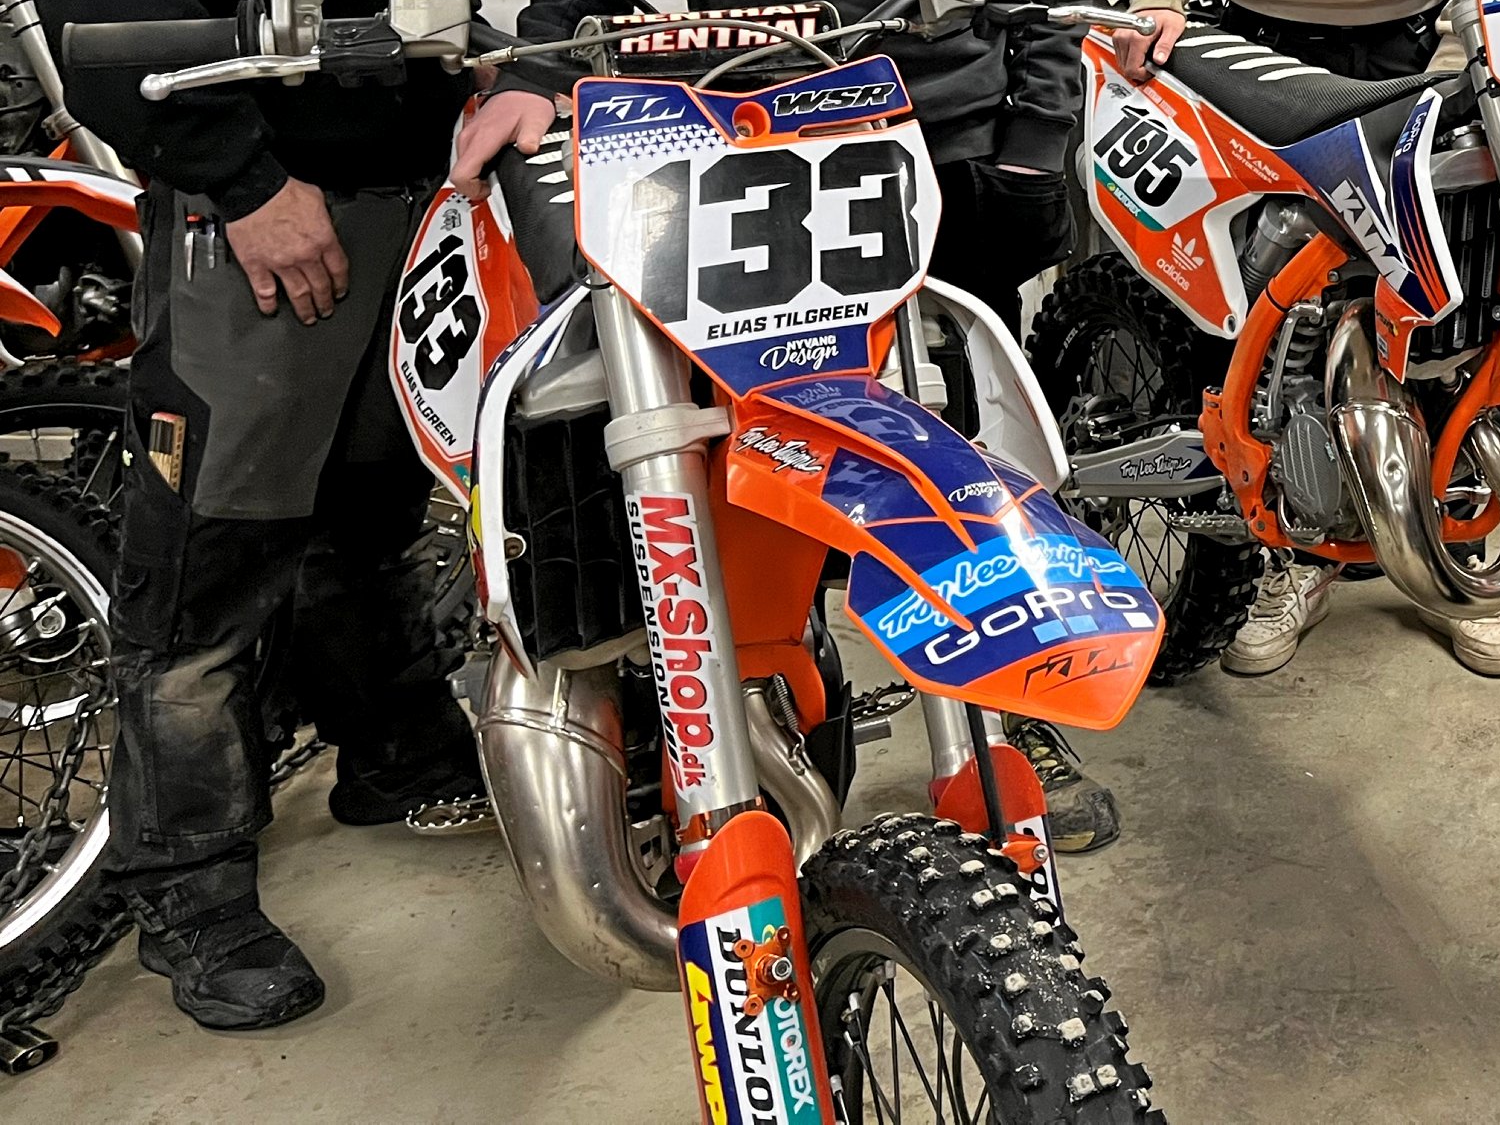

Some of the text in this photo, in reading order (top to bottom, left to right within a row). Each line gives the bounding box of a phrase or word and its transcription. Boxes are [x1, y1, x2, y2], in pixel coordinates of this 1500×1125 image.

[583, 94, 686, 129] KTM
[773, 81, 897, 117] WSR
[1093, 105, 1198, 207] 195
[1229, 139, 1280, 181] NYVANG
[632, 140, 921, 324] 133
[1329, 180, 1409, 292] KTM
[1156, 258, 1191, 292] adidas
[399, 235, 482, 390] 133
[706, 302, 870, 341] ELIAS TILGREEN
[787, 335, 837, 350] NYVANG
[759, 346, 840, 371] Design
[400, 360, 457, 447] ELIAS TILGREEN
[949, 484, 1007, 503] Design
[1120, 461, 1141, 480] Troy
[1139, 460, 1156, 475] Lee
[626, 500, 671, 708] SUSPENSION
[878, 586, 957, 638] Troy
[948, 555, 1021, 596] Lee
[923, 587, 1139, 666] GoPro
[1022, 648, 1137, 698] KTM
[716, 926, 780, 1125] DUNLO
[773, 996, 814, 1115] OTOREX
